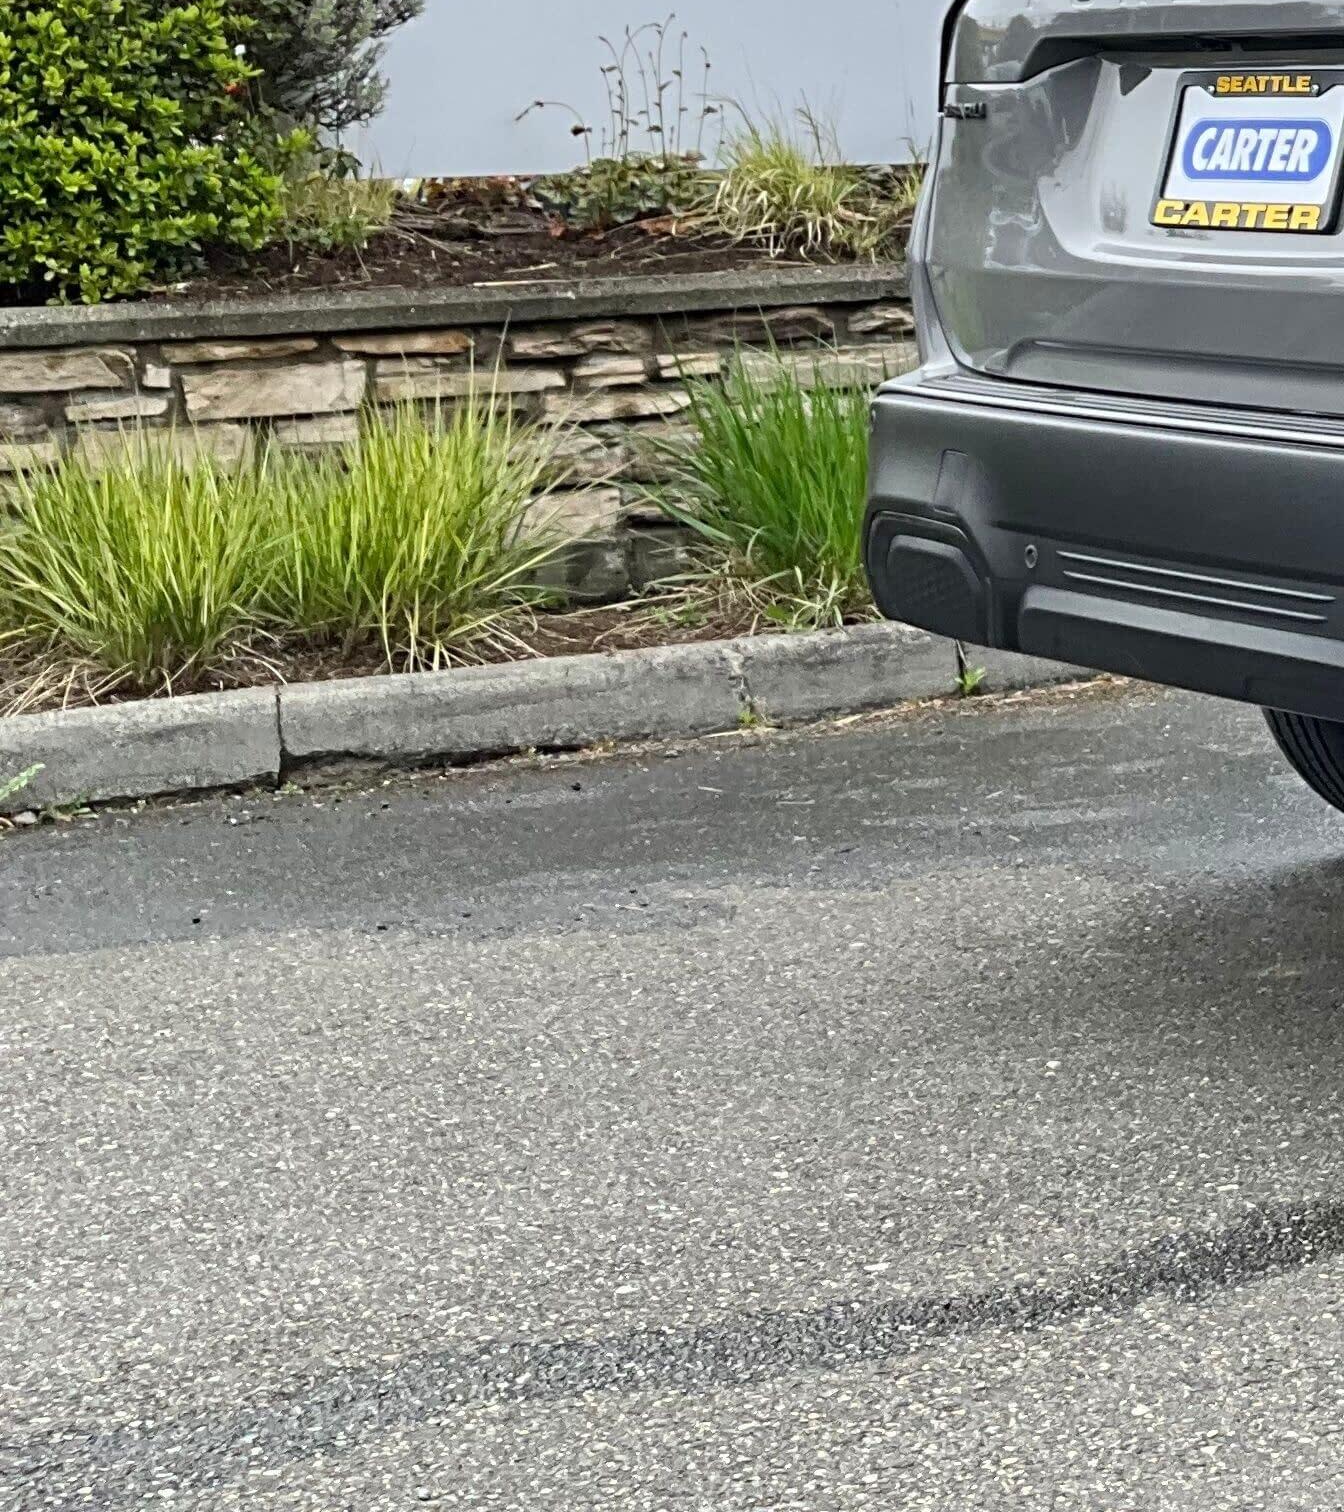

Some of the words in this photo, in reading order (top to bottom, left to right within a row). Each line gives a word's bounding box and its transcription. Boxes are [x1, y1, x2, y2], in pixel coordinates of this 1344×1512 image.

[1216, 75, 1312, 94] SEATTLE
[1192, 127, 1318, 173] CARTER
[1154, 199, 1321, 230] CARTER
